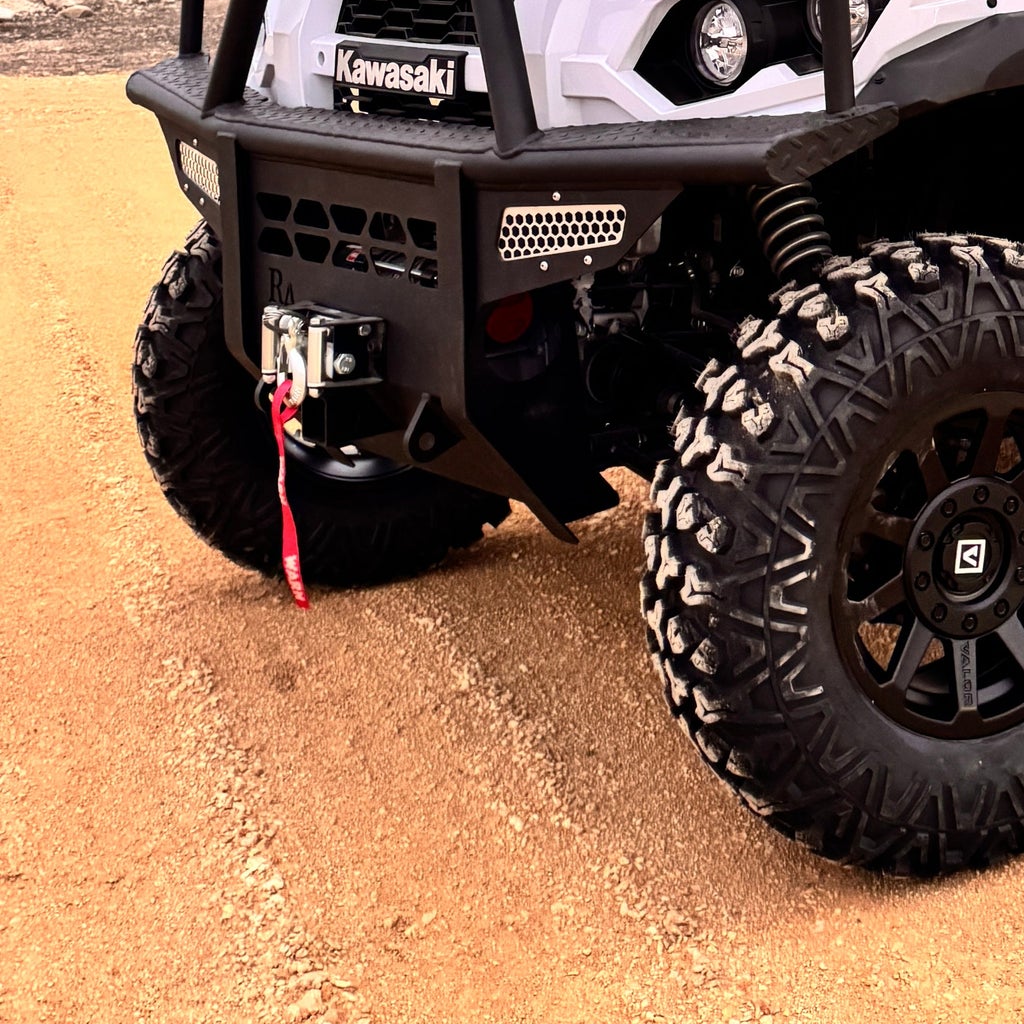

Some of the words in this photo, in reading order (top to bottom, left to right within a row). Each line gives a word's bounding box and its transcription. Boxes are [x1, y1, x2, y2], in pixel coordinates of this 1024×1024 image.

[336, 48, 455, 96] Kawasaki
[284, 554, 306, 602] WARN
[961, 641, 973, 706] VALOR
